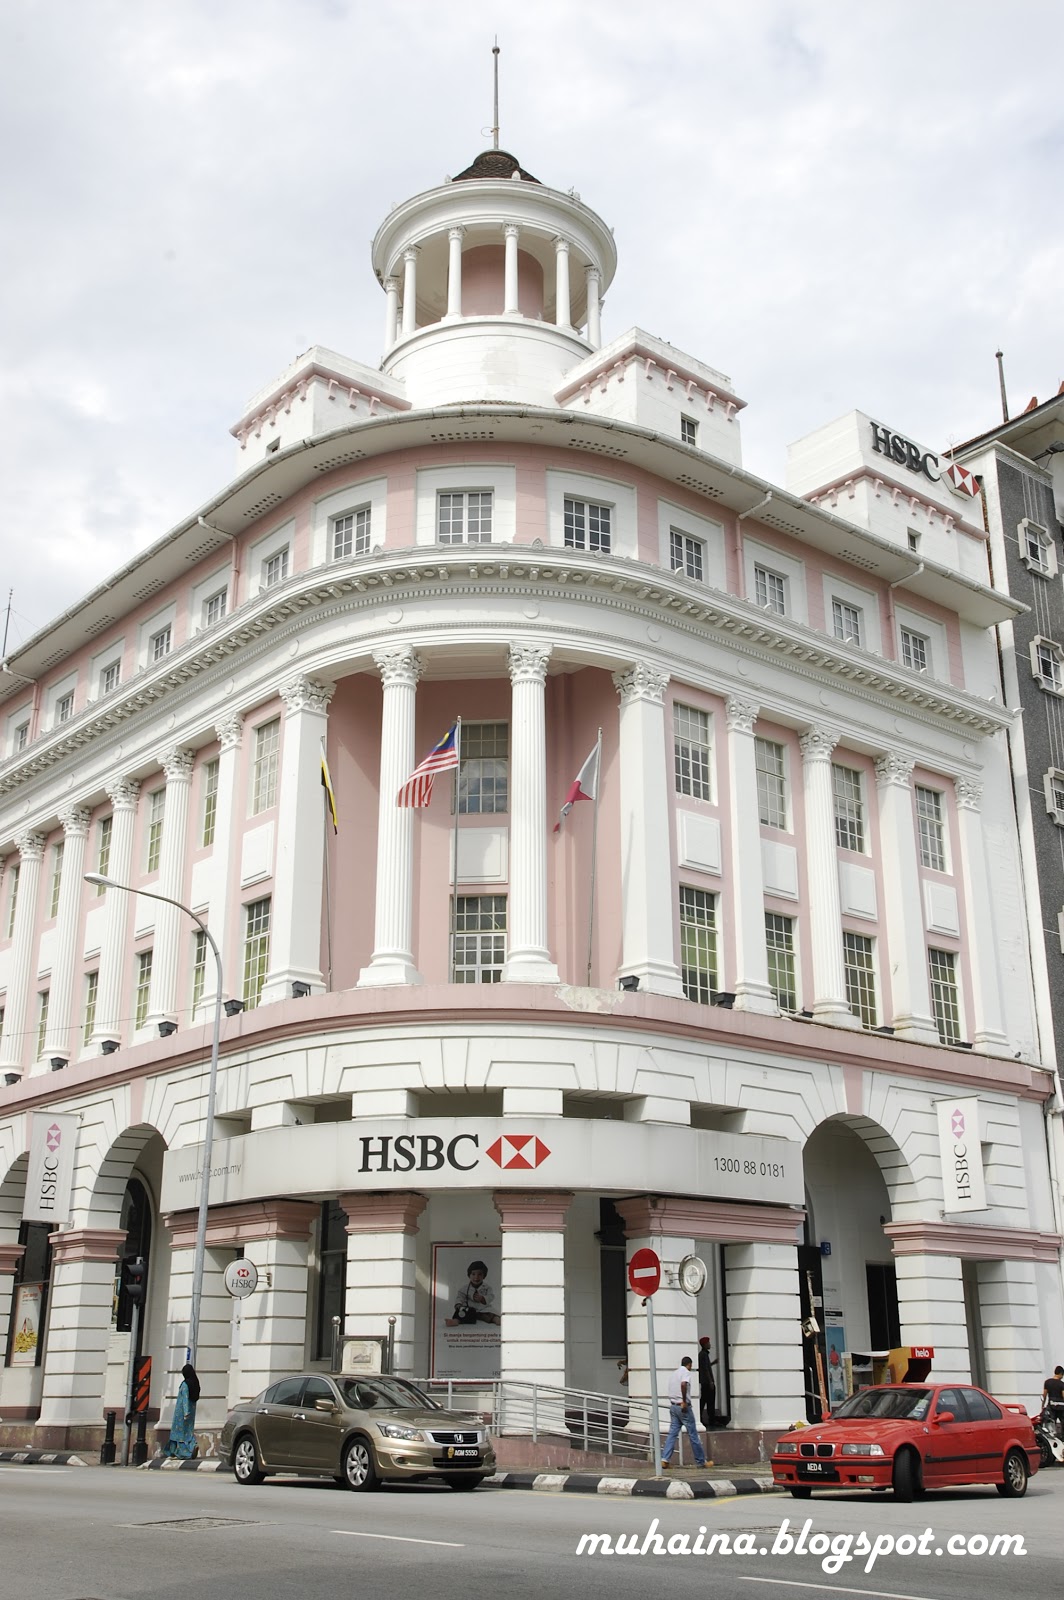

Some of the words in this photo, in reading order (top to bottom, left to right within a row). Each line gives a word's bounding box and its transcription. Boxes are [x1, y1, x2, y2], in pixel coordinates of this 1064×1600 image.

[869, 421, 940, 482] HSBC
[358, 1134, 479, 1172] HSBC
[714, 1157, 740, 1173] 1300
[743, 1160, 757, 1175] 88
[760, 1162, 785, 1178] 0181
[39, 1156, 59, 1210] HSBC
[178, 1164, 242, 1183] www.hsc.com.my
[953, 1143, 971, 1199] HSBC
[231, 1279, 254, 1288] HSBC
[915, 1348, 930, 1358] helo
